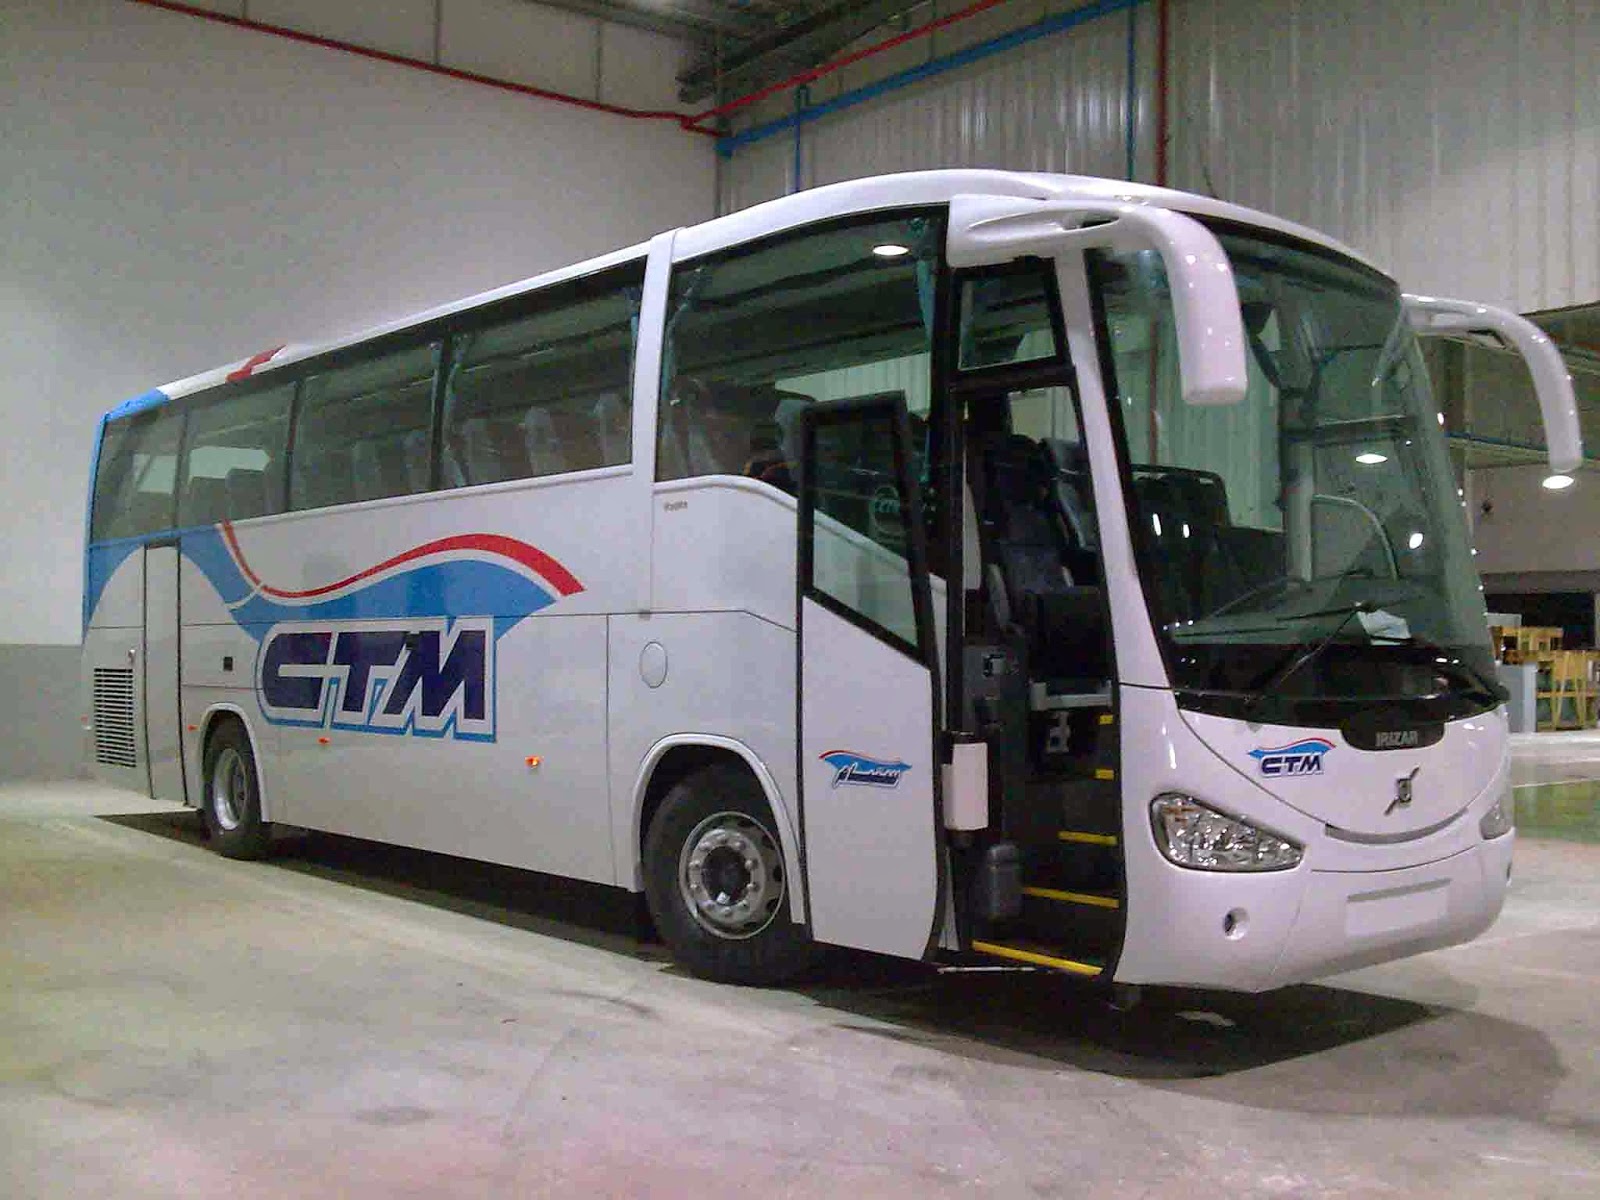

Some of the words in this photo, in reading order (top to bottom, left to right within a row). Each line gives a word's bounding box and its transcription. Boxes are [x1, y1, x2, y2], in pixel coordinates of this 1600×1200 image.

[260, 627, 488, 724] CTM
[1375, 730, 1419, 747] IRIZAR
[1261, 754, 1322, 776] CTM
